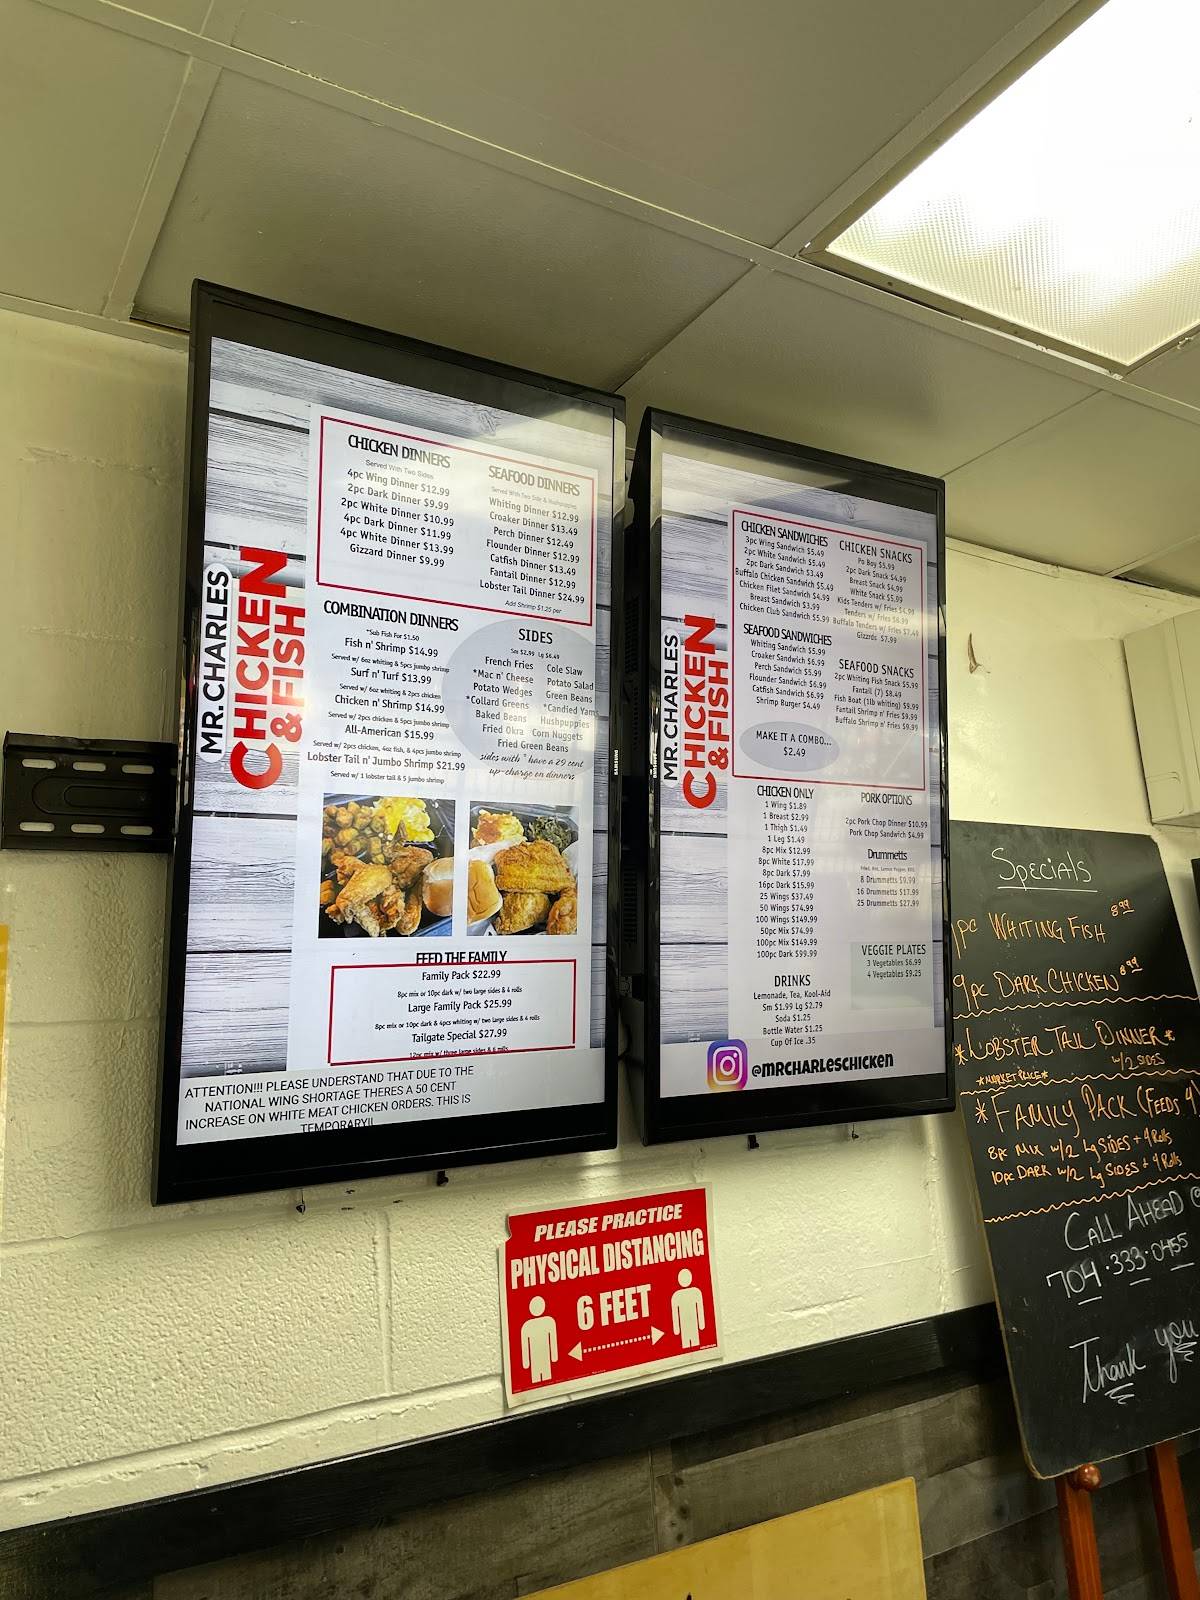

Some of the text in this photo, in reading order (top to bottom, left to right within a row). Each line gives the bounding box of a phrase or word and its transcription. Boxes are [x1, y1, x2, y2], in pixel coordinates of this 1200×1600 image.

[348, 434, 451, 469] CHICKEN DINNERS
[348, 468, 450, 497] 4pc Wing Dinner $12.99
[489, 465, 581, 497] SEAFOOD DINNERS
[348, 483, 449, 511] 2pc Dark Dinner $9.99
[342, 497, 454, 527] 2pc White Dinner $10.99
[741, 520, 828, 548] CHICKEN SANDWICHES
[840, 540, 913, 564] CHICKEN SNACKS
[480, 580, 585, 604] Lobster Tail Dinner $24.99
[324, 600, 459, 632] COMBINATION DINNERS
[518, 628, 553, 645] SIDES
[744, 623, 832, 646] SEAFOOD SANDWICHES
[345, 638, 439, 658] Fish n' Shrimp $14.99
[751, 639, 826, 656] Whiting Sandwich $5.99
[201, 570, 229, 754] MR.CHARLES
[230, 546, 288, 790] CHICKEN
[486, 656, 534, 670] French Fries
[839, 659, 914, 679] SEAFOOD SNACKS
[270, 604, 306, 742] & FISH
[474, 682, 533, 698] Potato Wedges
[752, 685, 824, 700] Catfish Sandwich $6.99
[335, 694, 445, 714] Chicken n' Shrimp $14.99
[664, 635, 678, 781] MR.CHARLES
[683, 615, 717, 808] CHICKEN
[756, 696, 821, 711] Shrimp Burger $4.49
[708, 660, 729, 770] & FISH
[345, 725, 434, 741] All-American $15.99
[757, 731, 778, 741] MAKE
[780, 733, 788, 742] IT
[791, 734, 796, 743] A
[784, 746, 806, 757] $2.49
[757, 785, 814, 800] CHICKEN ONLY
[862, 792, 913, 806] PORK OPTIONS
[762, 846, 774, 855] 8pc
[789, 847, 811, 855] $12.99
[868, 849, 908, 861] Drummetts
[771, 916, 790, 925] Wings
[792, 916, 818, 924] $149.99
[416, 951, 510, 965] FEED THE FAMILY
[862, 944, 926, 956] VEGGIE PLATES
[422, 970, 501, 982] Family Pack $22.99
[775, 974, 811, 987] DRINKS
[754, 990, 831, 1000] Lemonade, Tea, Kool-Aid
[408, 999, 512, 1014] Large Family Pack $25.99
[412, 1028, 507, 1043] Tailgate Special $27.99
[763, 1027, 783, 1035] Bottle
[805, 1025, 823, 1033] $1.25
[771, 1039, 783, 1048] Cup
[185, 1066, 474, 1099] ATTENTION!!! PLEASE UNDERSTAND THAT DUE TO THE
[205, 1081, 457, 1113] NATIONAL WING SHORTAGE THERES A 50 CENT
[186, 1094, 471, 1130] INCREASE ON WHITE MEAT CHICKEN ORDERS. THIS IS
[534, 1204, 683, 1243] PLEASE PRACTICE
[511, 1228, 705, 1290] PHYSICAL DISTANCING
[577, 1284, 651, 1331] 6 FEET
